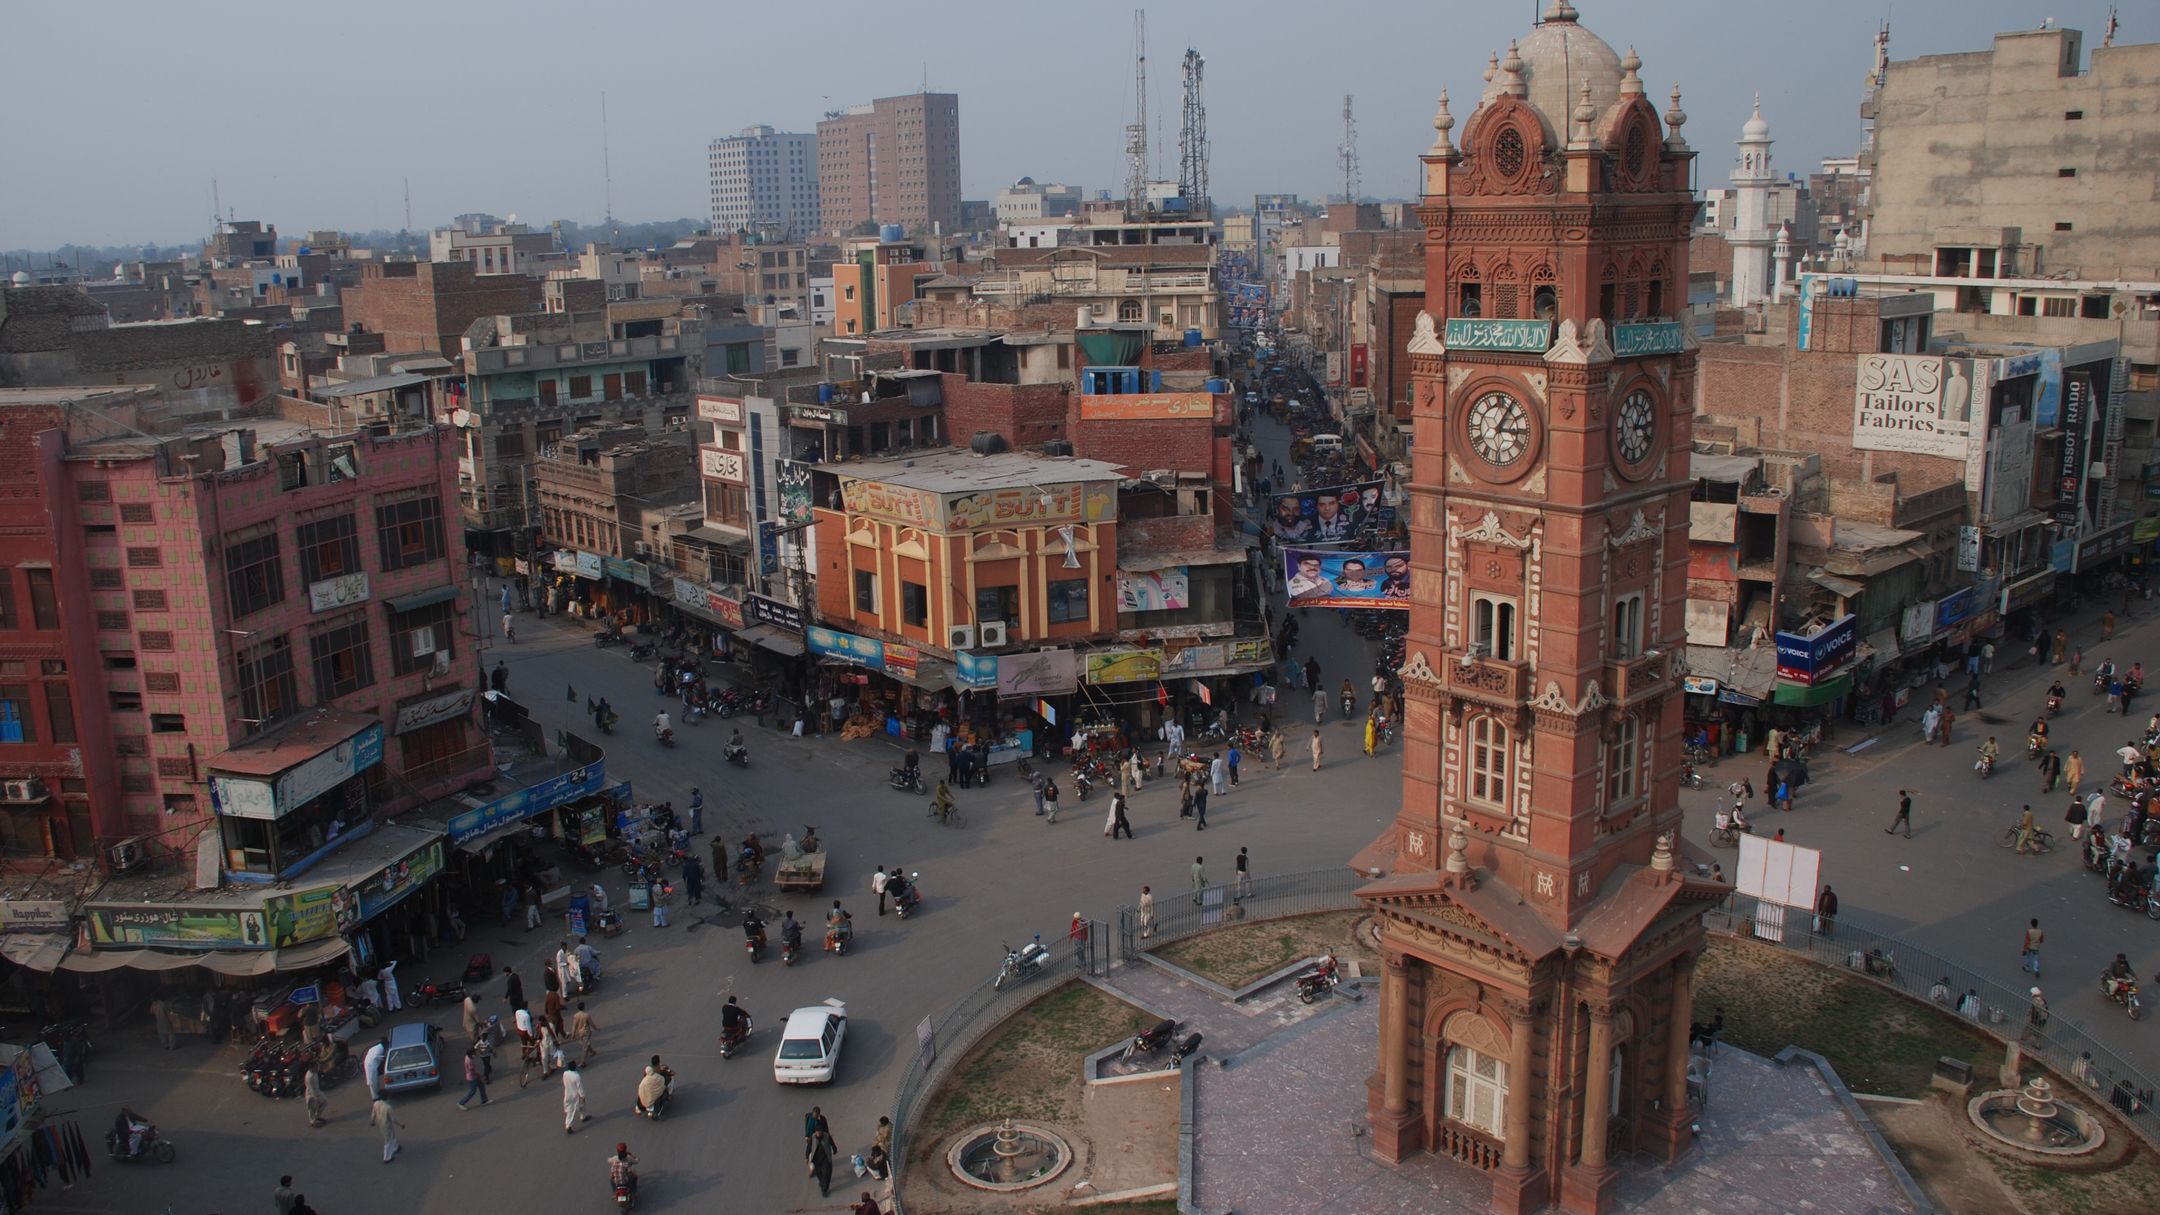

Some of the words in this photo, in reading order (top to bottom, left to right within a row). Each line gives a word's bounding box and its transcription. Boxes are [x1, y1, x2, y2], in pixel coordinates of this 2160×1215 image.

[1860, 356, 1940, 394] SAS
[1860, 392, 1935, 414] Tailors
[2067, 381, 2080, 423] RADO
[1859, 411, 1934, 432] Fabrics
[2063, 429, 2076, 476] TISSOT
[869, 493, 913, 516] BUTT
[995, 495, 1070, 518] BUTT
[1826, 630, 1852, 652] VOICE
[1787, 647, 1809, 659] VOICE
[571, 769, 586, 781] 24
